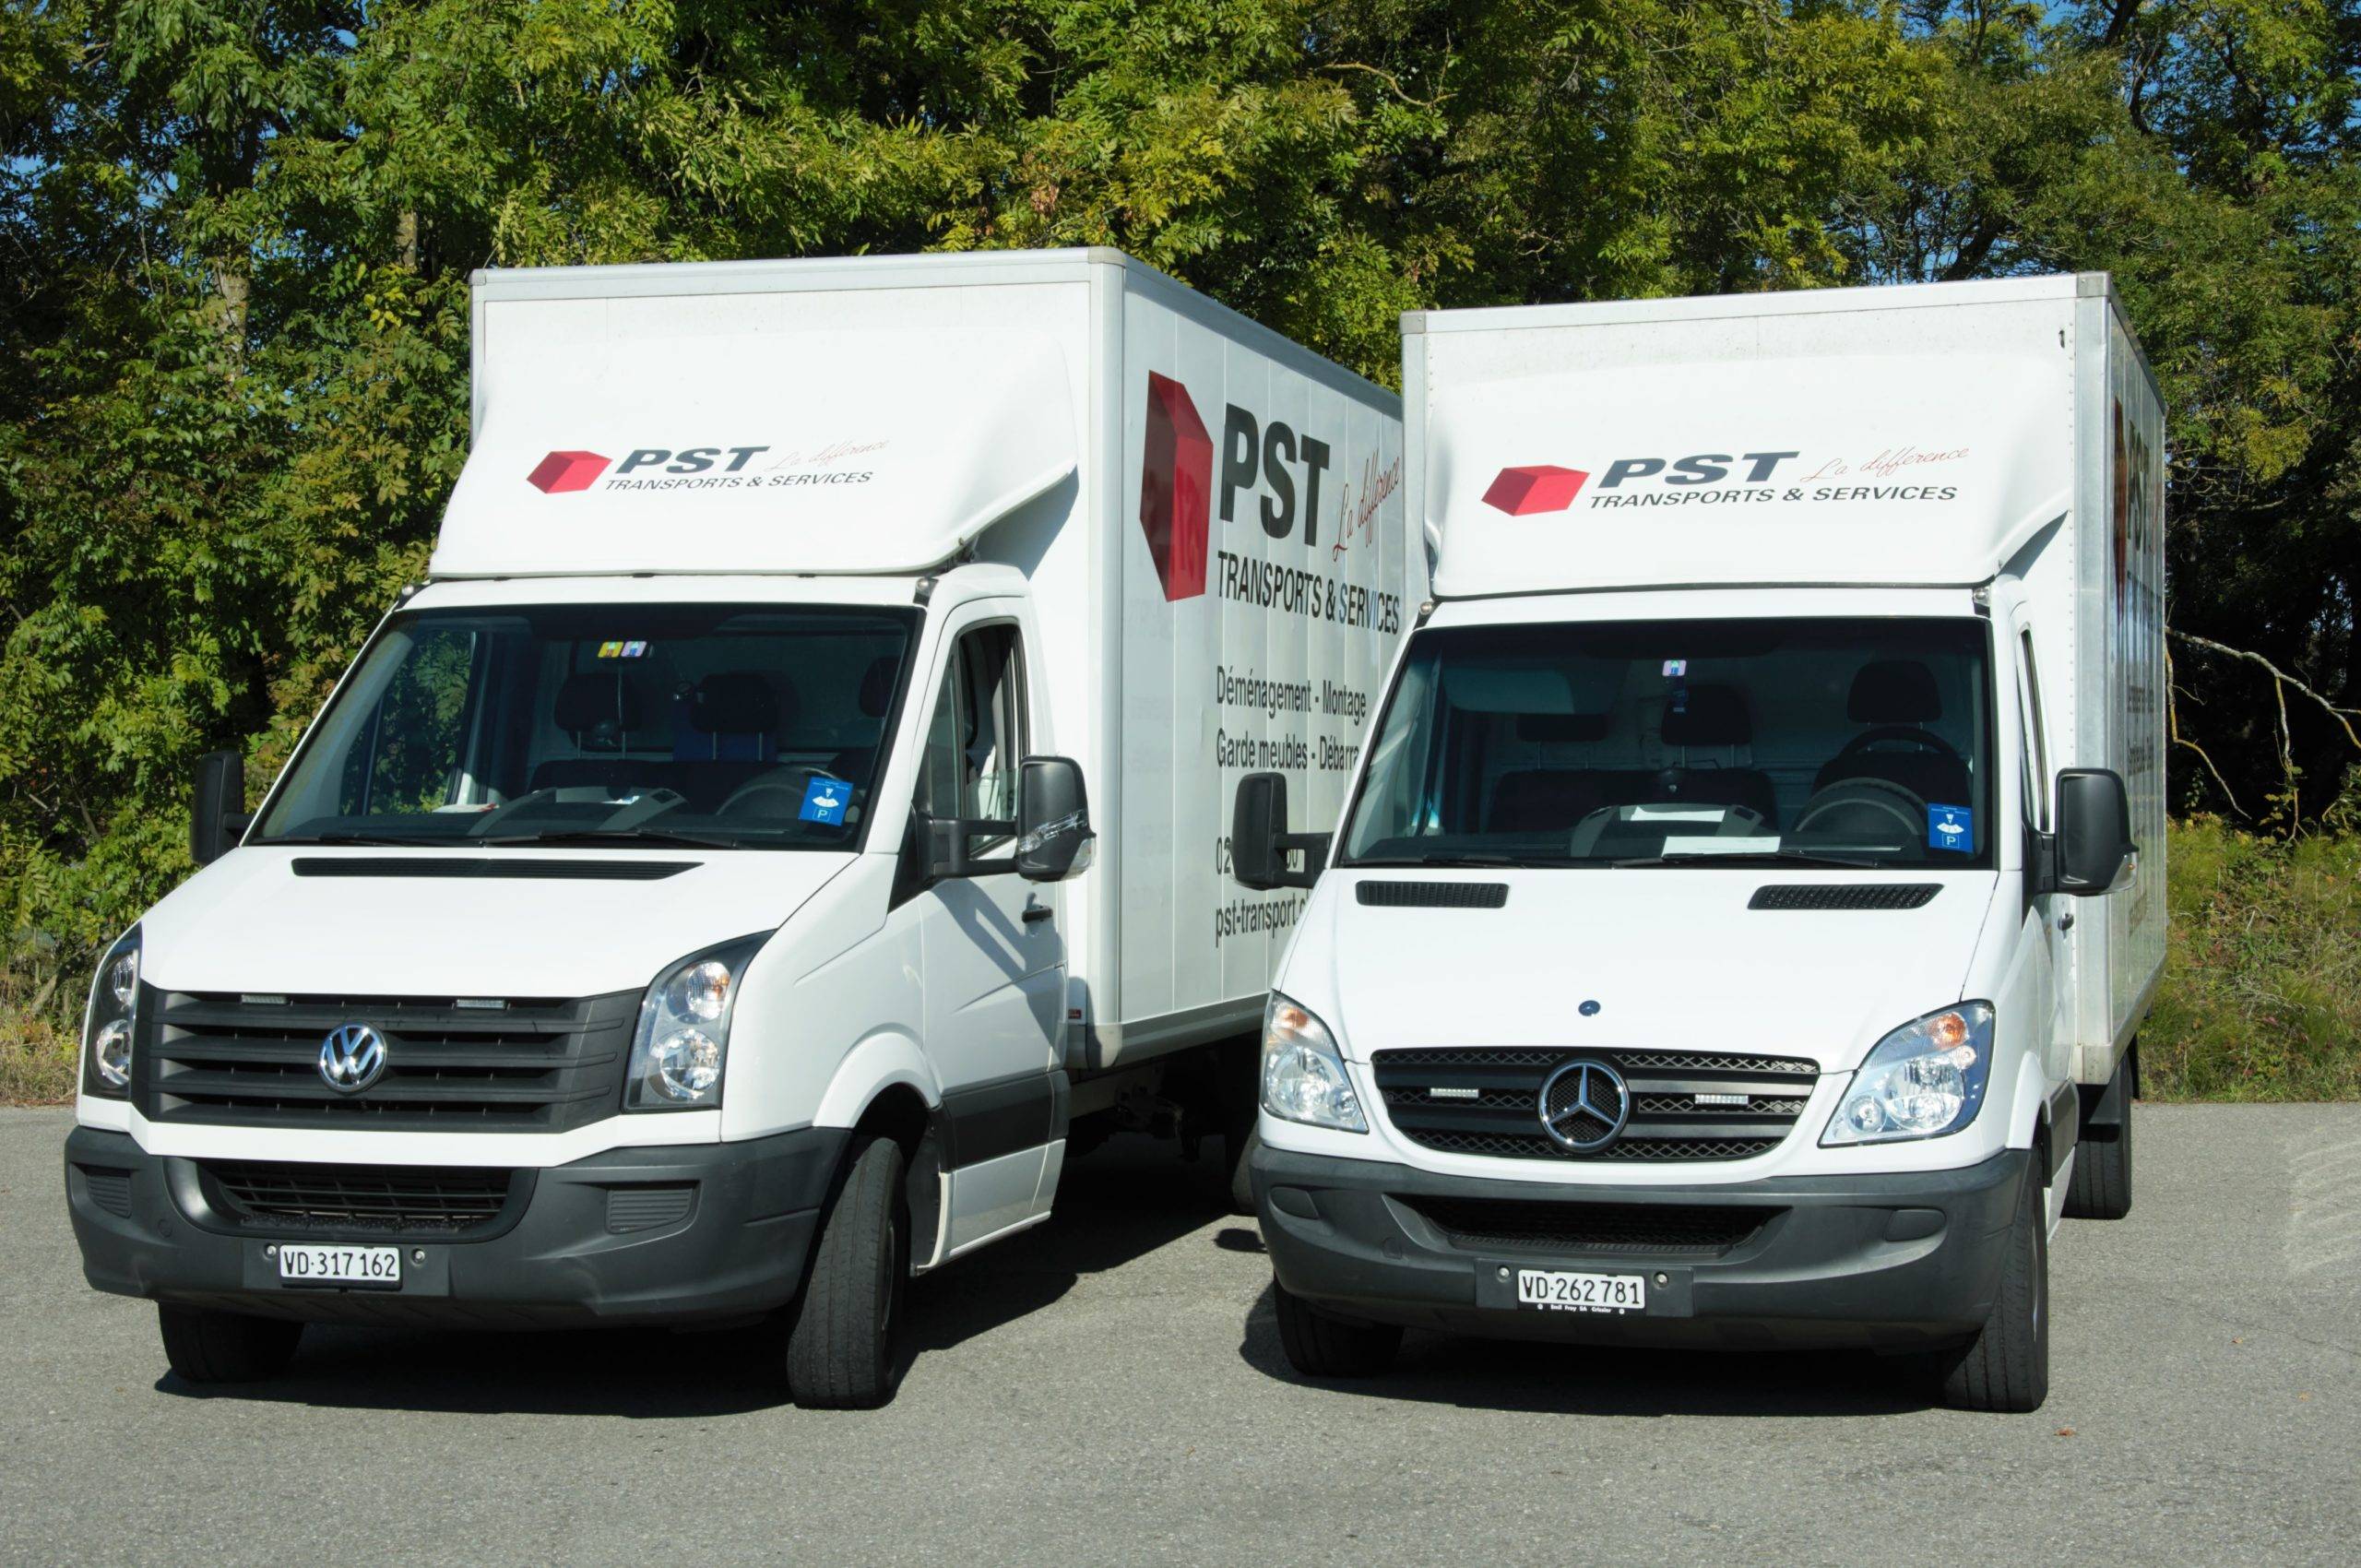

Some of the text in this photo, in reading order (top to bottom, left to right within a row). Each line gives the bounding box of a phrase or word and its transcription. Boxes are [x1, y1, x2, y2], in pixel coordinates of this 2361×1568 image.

[606, 471, 874, 491] TRANSPORTS & SERVICES
[615, 445, 771, 474] PST
[1219, 401, 1331, 547] PST
[1598, 450, 1801, 488] PST
[1799, 457, 1849, 483] La
[1591, 485, 1958, 509] TRANSPORTS & SERVICES
[1333, 482, 1354, 563] La
[1217, 551, 1400, 636] TRANSPORTS & SERVICES
[1216, 665, 1311, 719] Déménagement
[1323, 679, 1367, 727] Montage
[1216, 727, 1256, 768] Garde
[1259, 733, 1308, 770] meubles
[1216, 889, 1310, 948] pst-transport.c
